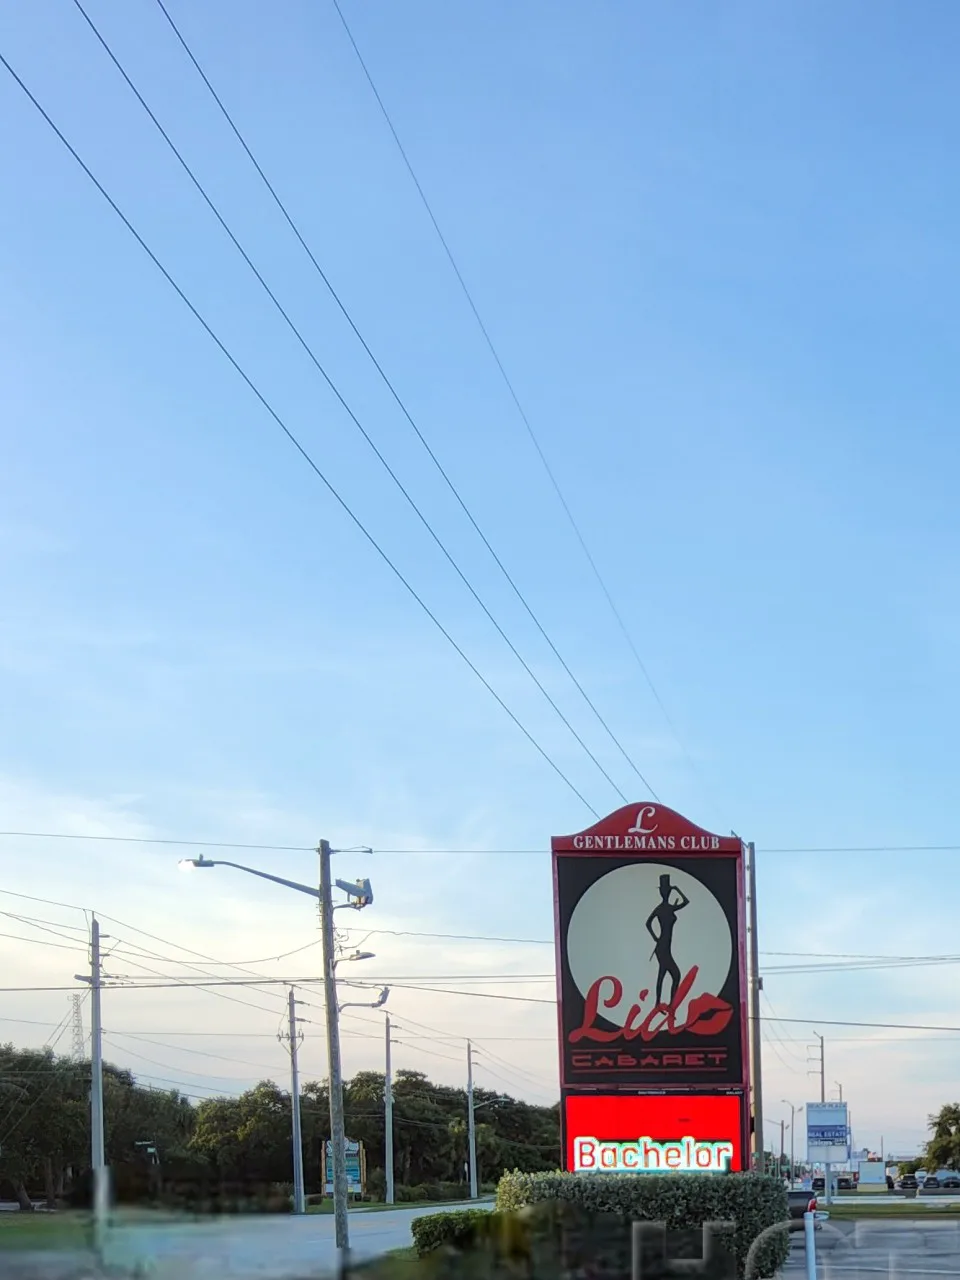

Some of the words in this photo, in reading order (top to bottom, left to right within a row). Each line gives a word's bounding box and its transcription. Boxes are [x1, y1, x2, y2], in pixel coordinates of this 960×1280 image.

[628, 806, 658, 834] L
[573, 836, 675, 849] GENTLEMANS
[680, 836, 720, 849] CLUB
[571, 1053, 728, 1067] CABARET
[577, 1140, 731, 1168] Bachelor
